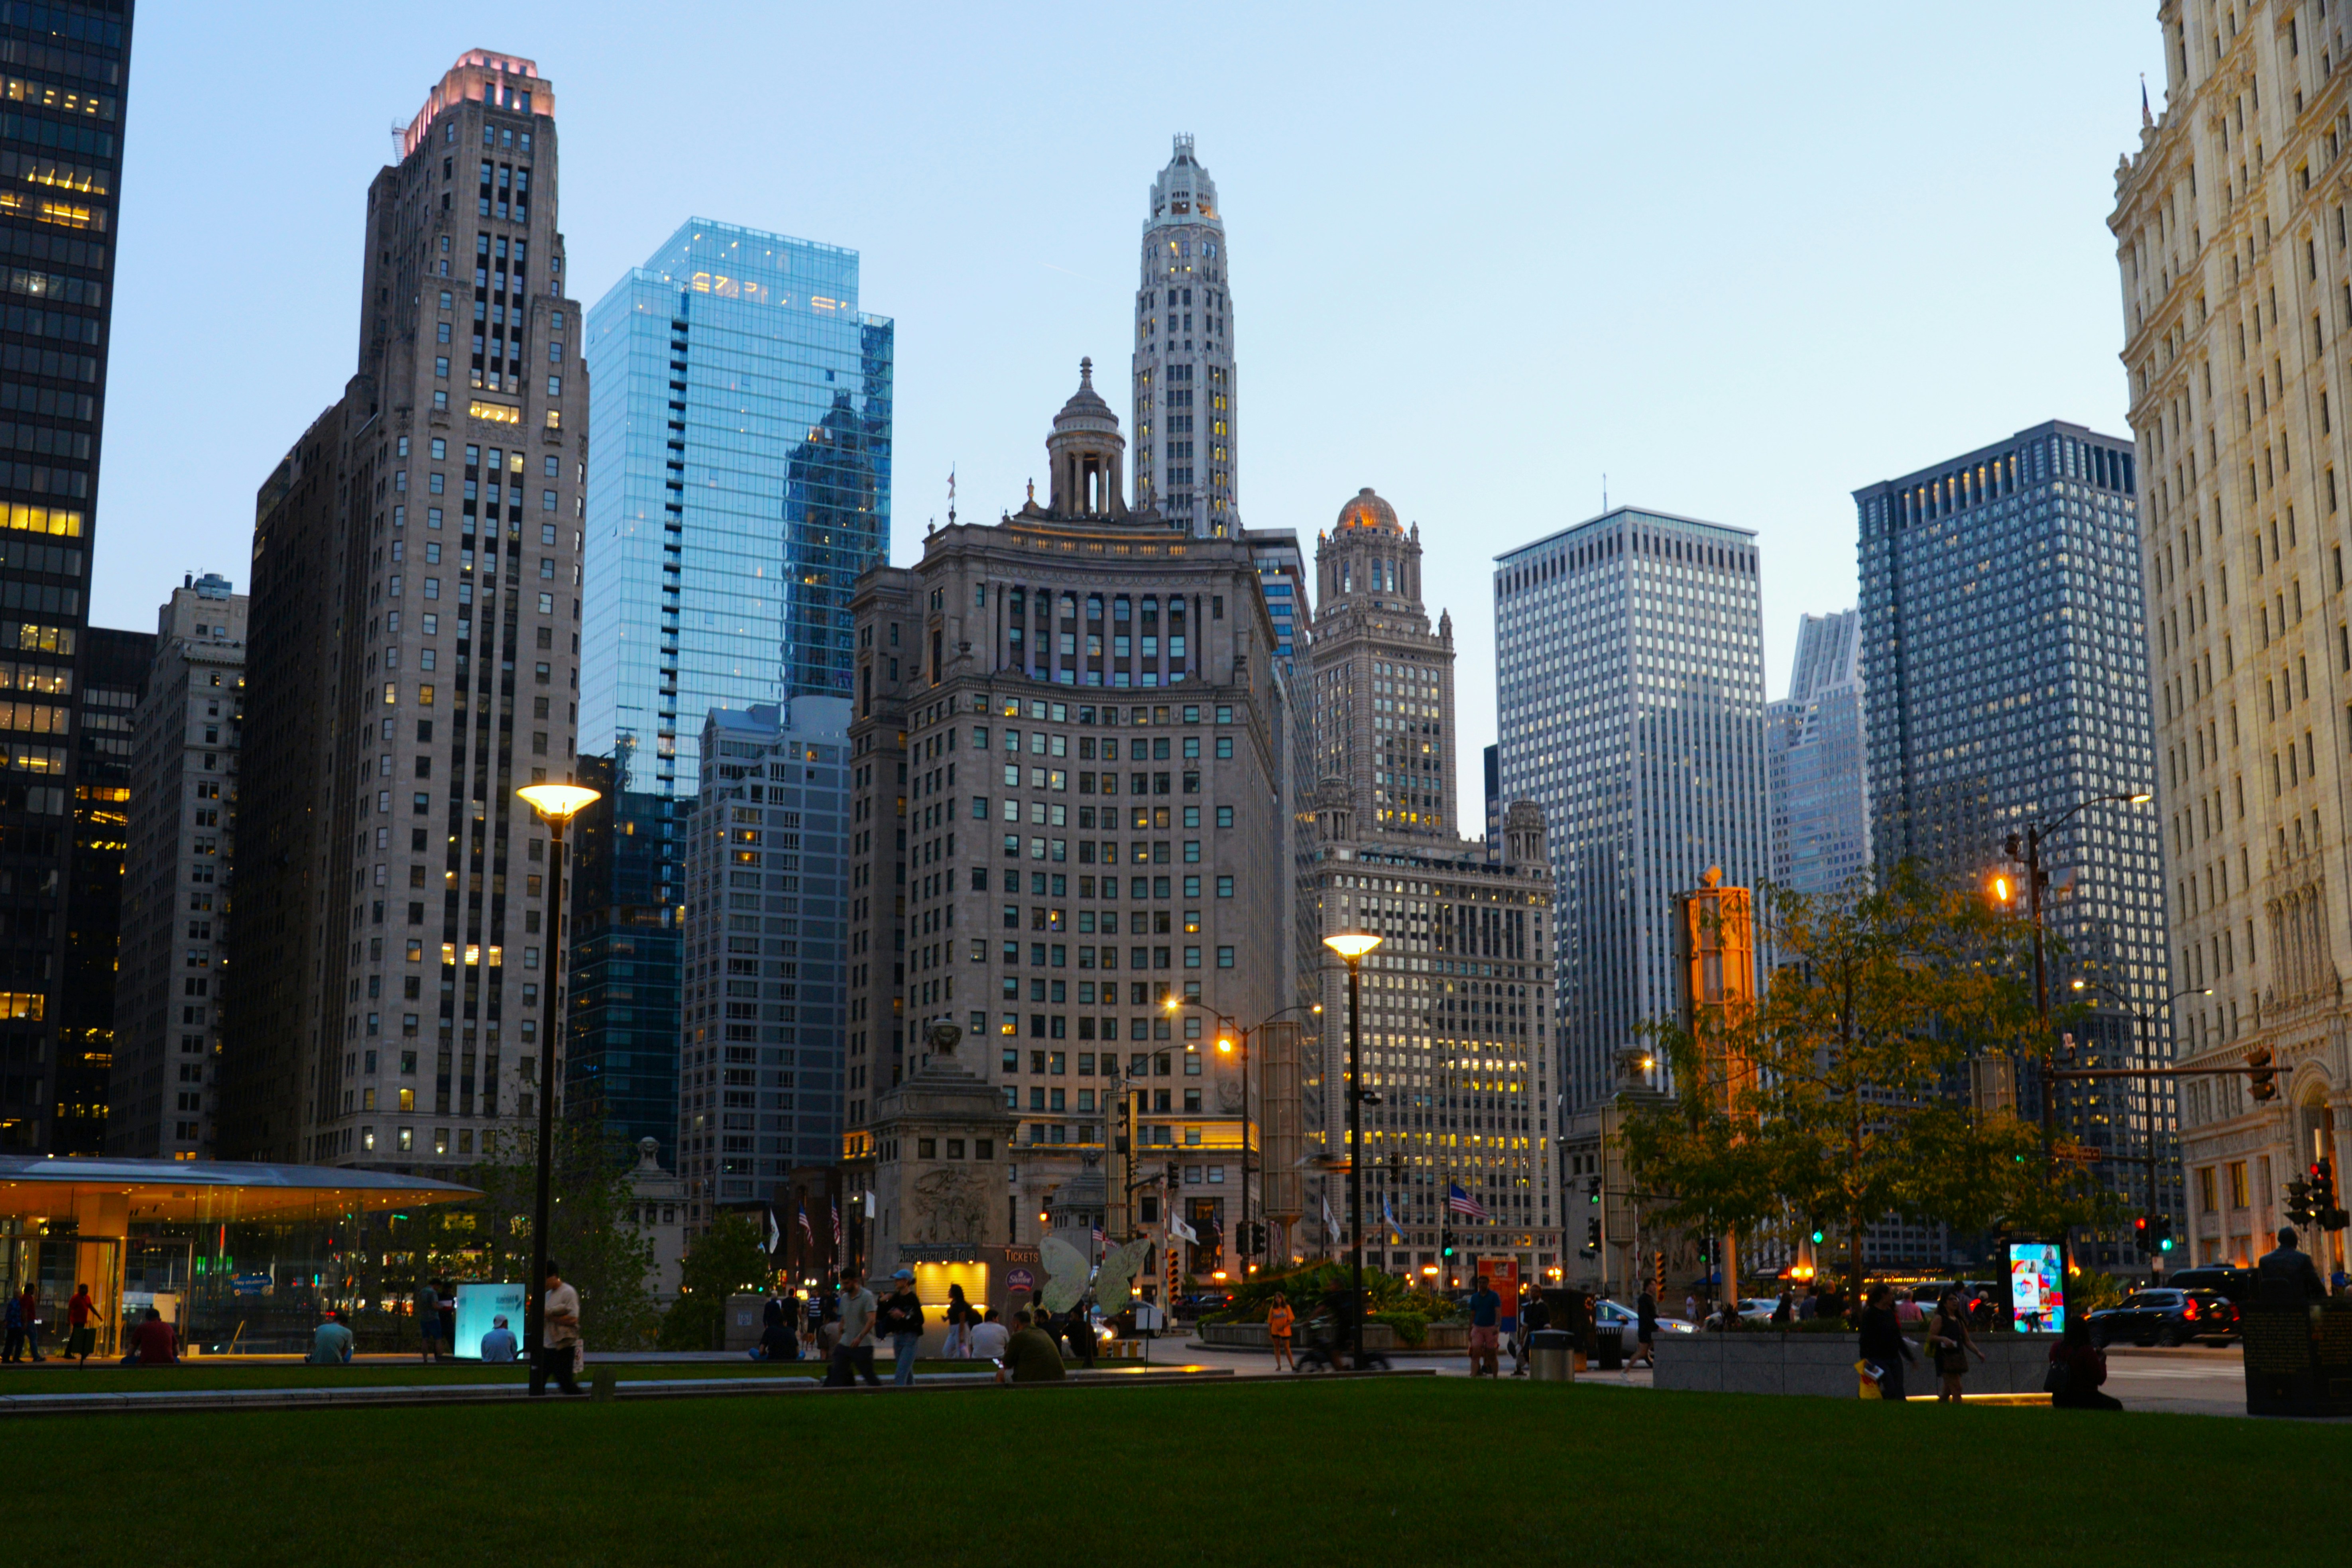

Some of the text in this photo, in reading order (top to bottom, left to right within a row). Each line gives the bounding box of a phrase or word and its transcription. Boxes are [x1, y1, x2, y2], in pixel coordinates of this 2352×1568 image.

[899, 1249, 975, 1263] ARCHITECTURE TOUR
[1005, 1249, 1038, 1262] TICKETS
